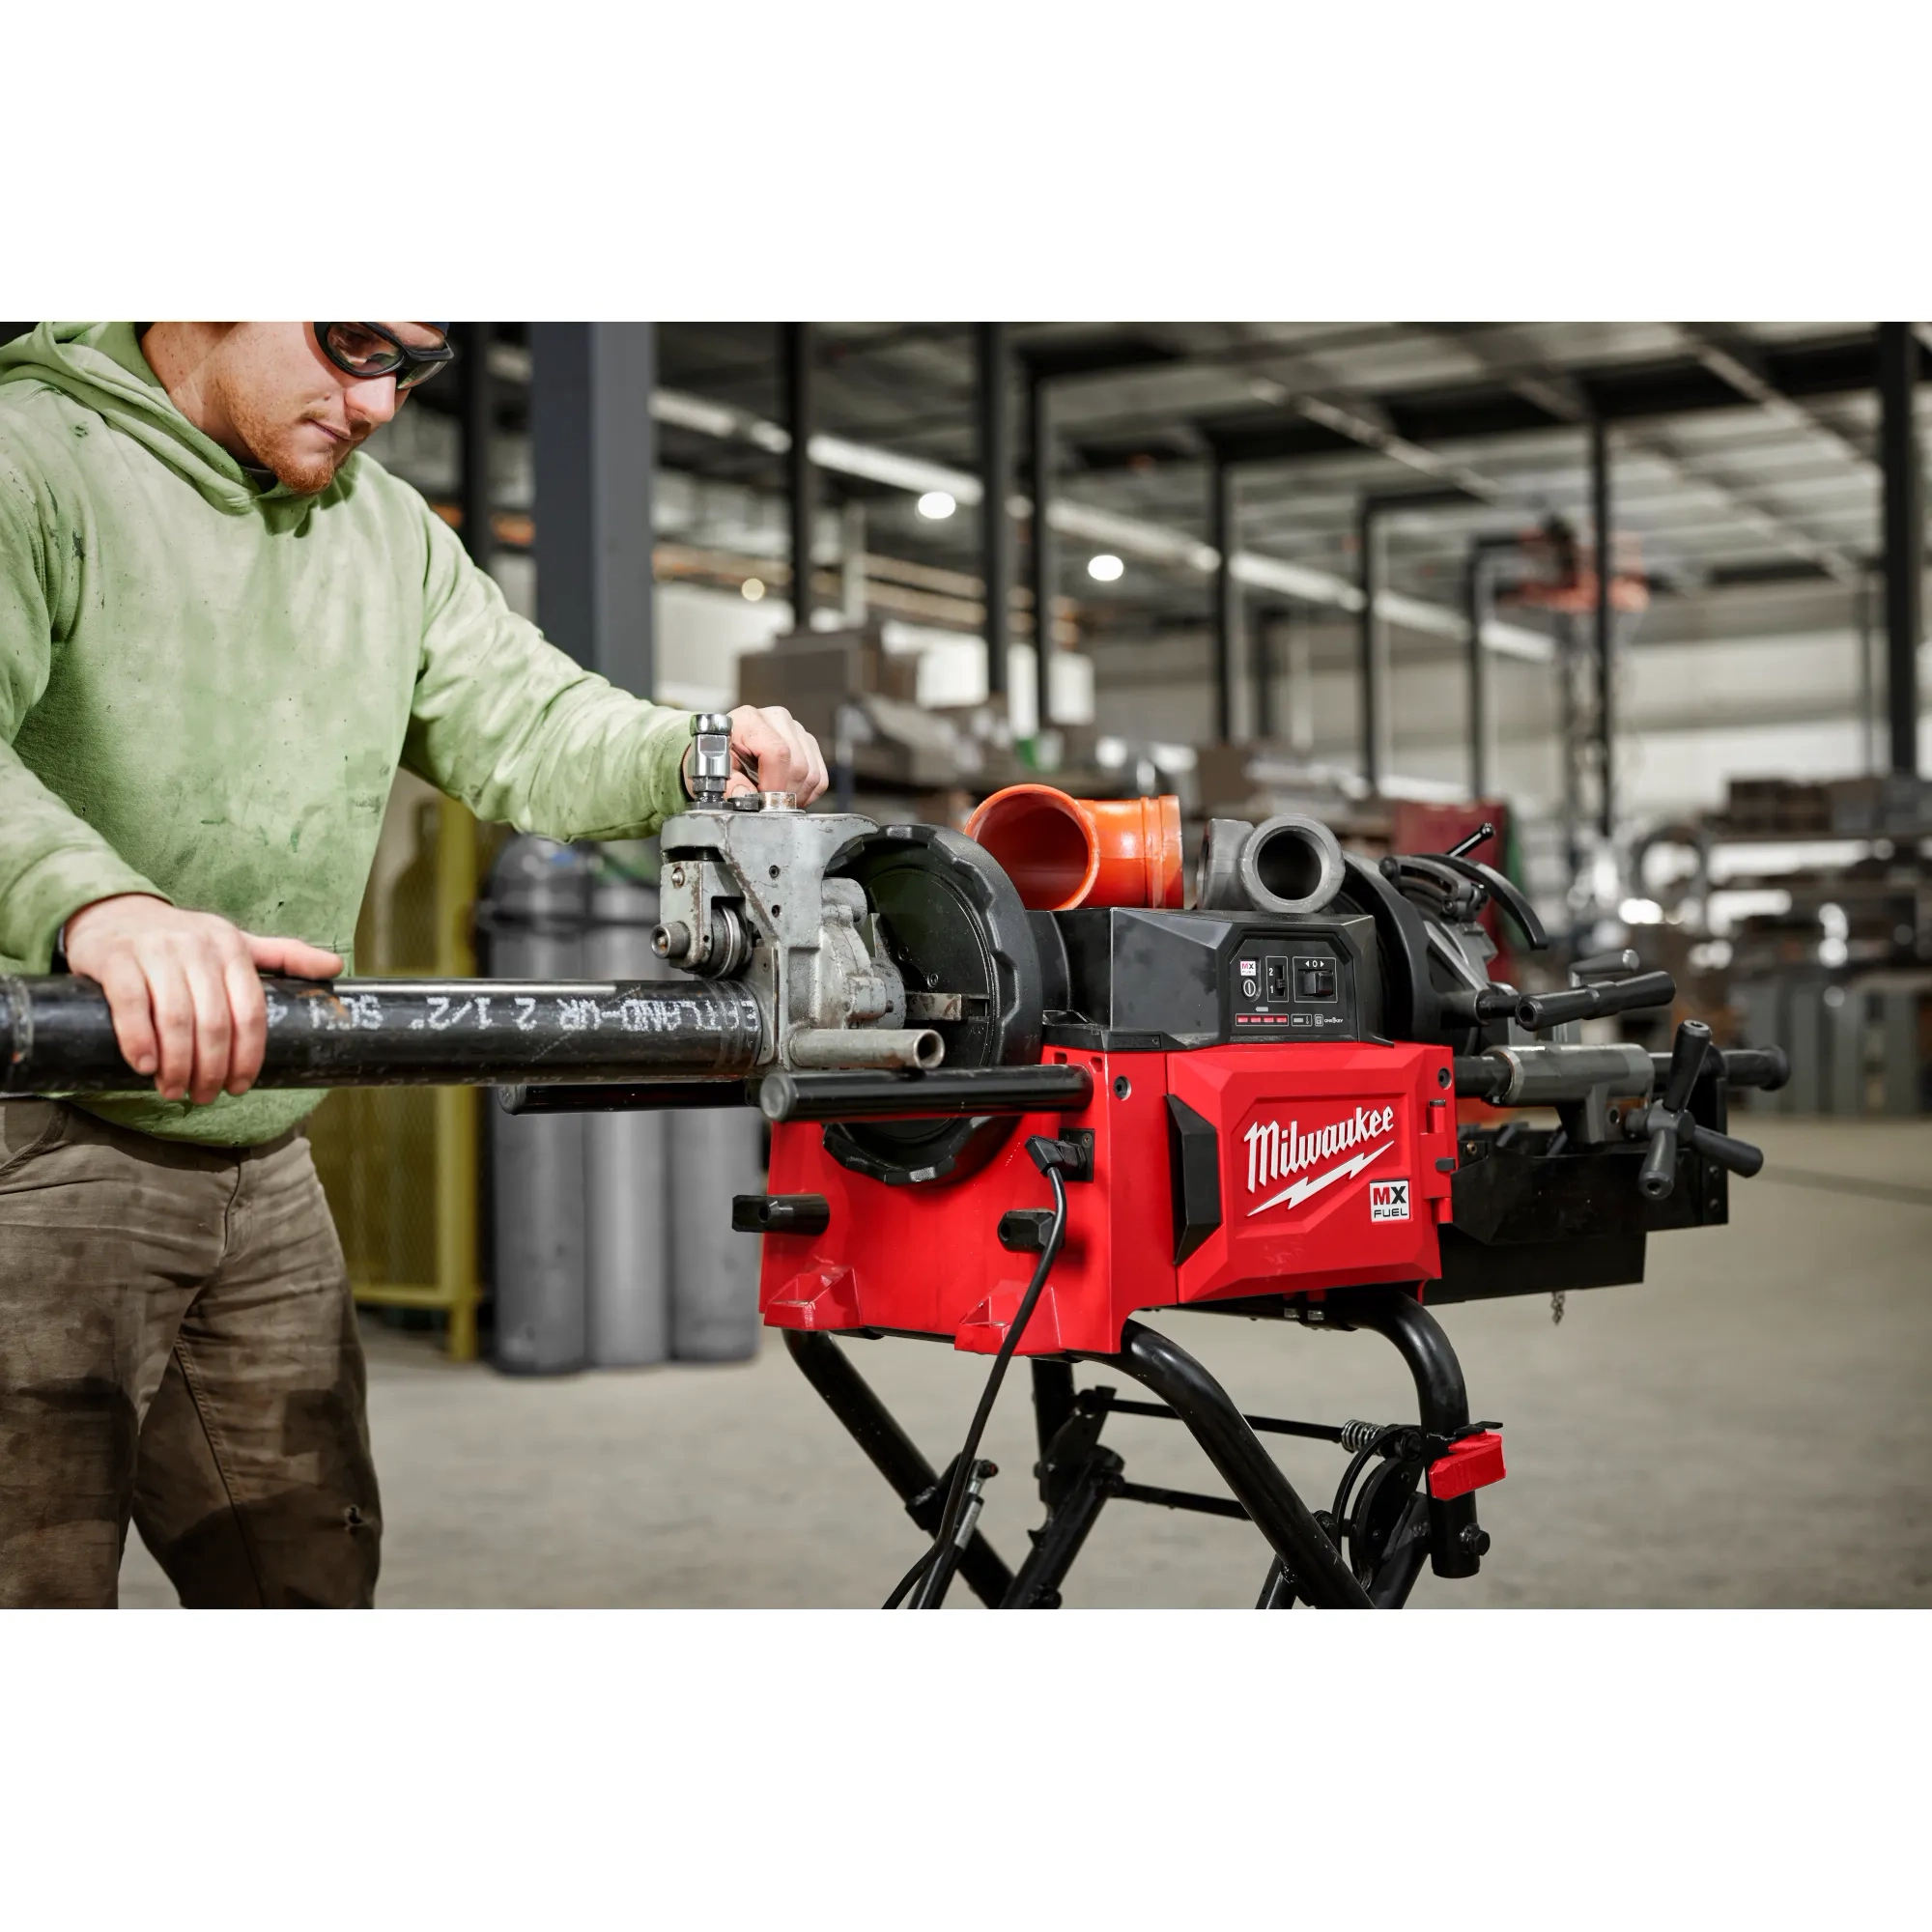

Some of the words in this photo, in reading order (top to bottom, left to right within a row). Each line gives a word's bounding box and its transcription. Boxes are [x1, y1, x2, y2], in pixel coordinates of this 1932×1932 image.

[1268, 968, 1274, 977] 2
[514, 997, 537, 1031] 2
[1244, 1106, 1393, 1194] Milwaukee
[1373, 1185, 1406, 1206] MX
[1374, 1208, 1408, 1218] FUEL
